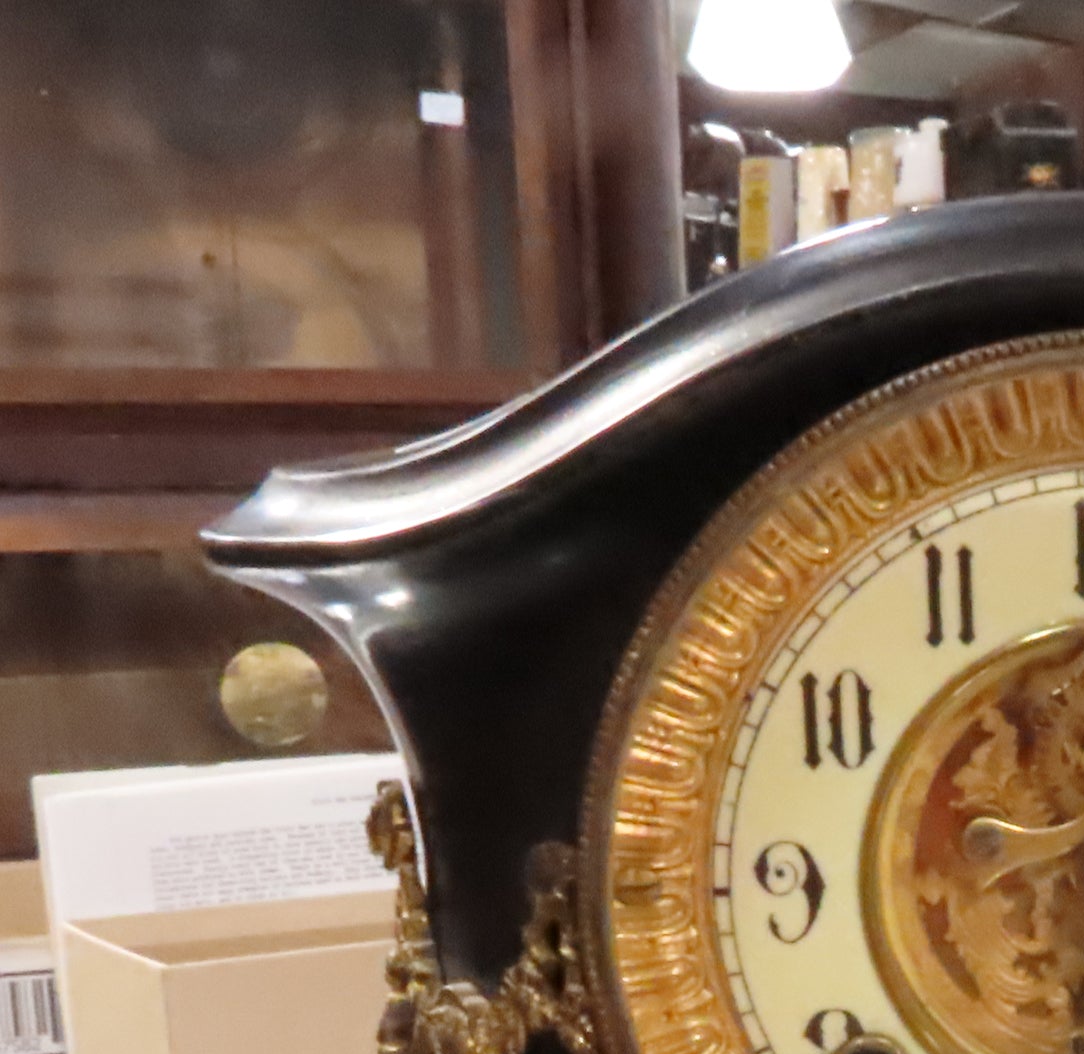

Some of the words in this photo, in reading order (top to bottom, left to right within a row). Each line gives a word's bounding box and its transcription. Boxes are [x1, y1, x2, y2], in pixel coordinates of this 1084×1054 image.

[925, 543, 975, 647] 11
[800, 669, 875, 769] 10
[754, 840, 826, 944] 9
